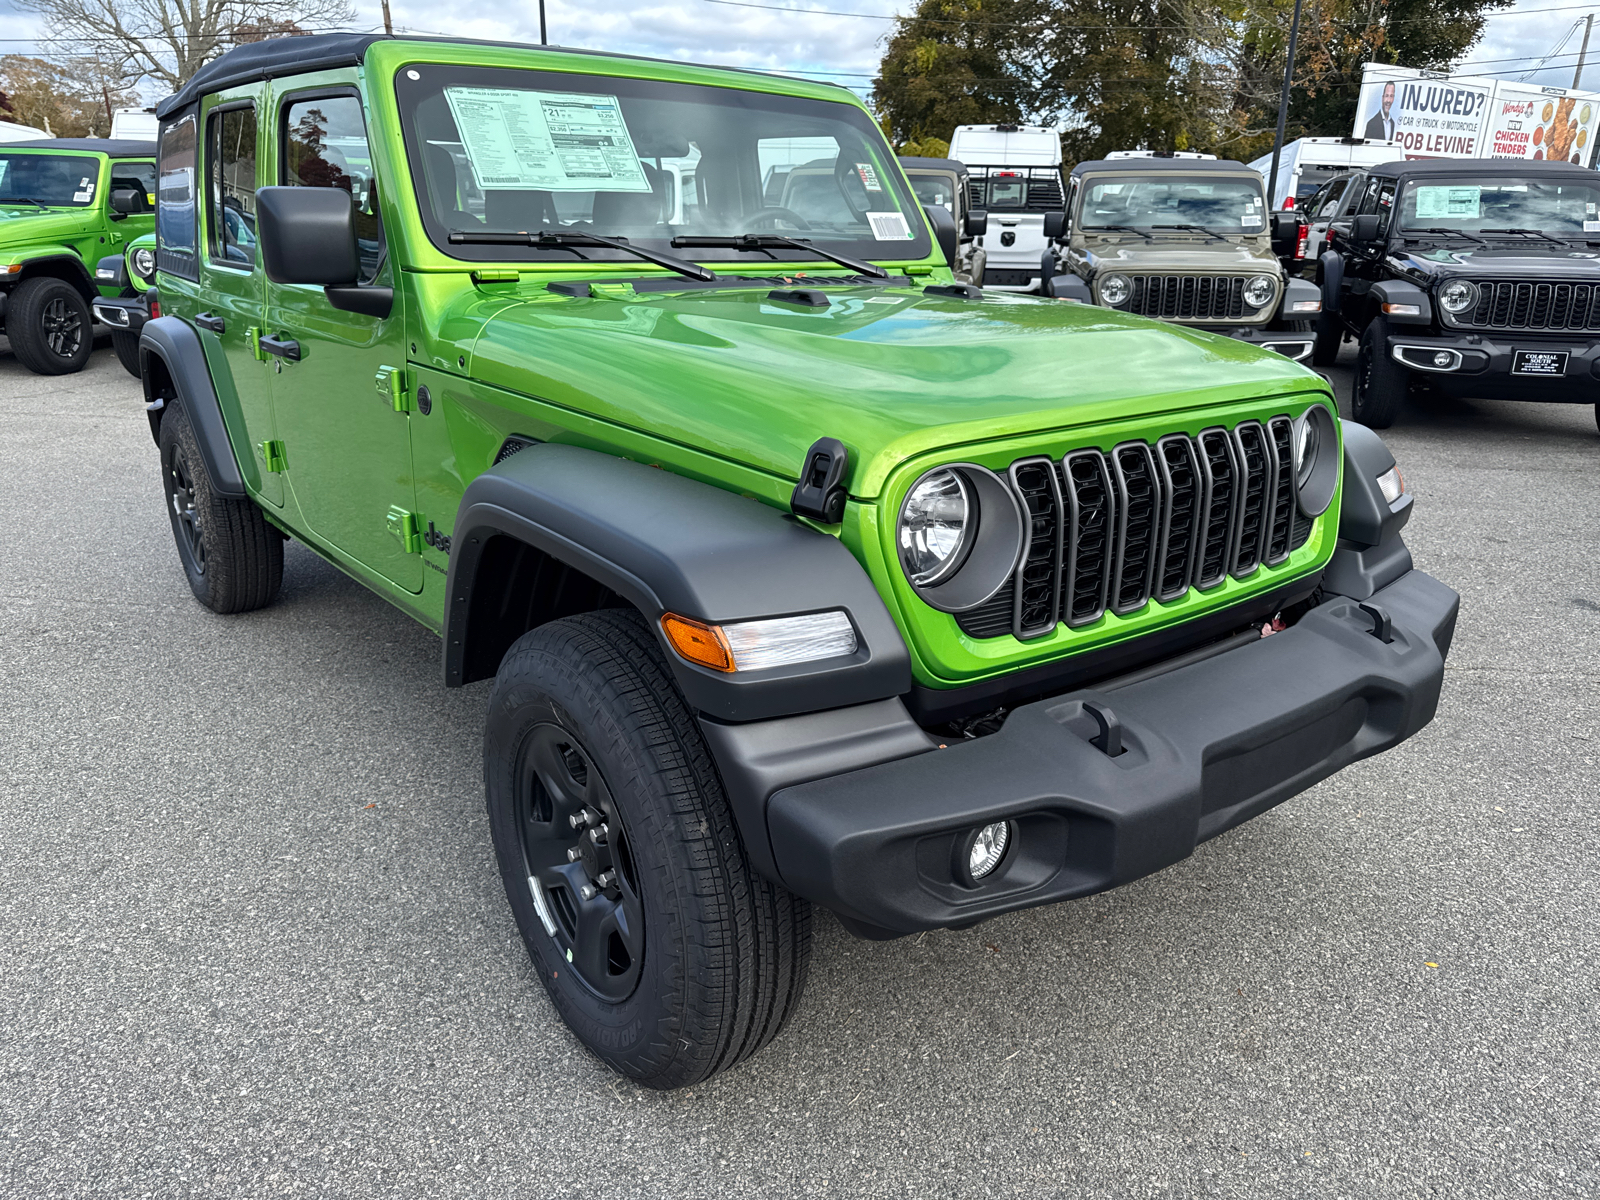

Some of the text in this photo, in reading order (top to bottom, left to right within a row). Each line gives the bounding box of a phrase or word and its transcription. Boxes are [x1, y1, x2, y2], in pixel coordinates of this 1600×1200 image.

[1400, 83, 1485, 118] INJURED?
[548, 108, 560, 117] 21
[1502, 101, 1524, 117] Wendy's
[1403, 116, 1478, 132] CAR TRUCK MOTORCYCLE
[1426, 134, 1475, 154] LEVINE
[1495, 130, 1530, 143] CHICKEN
[1493, 142, 1527, 155] TENDERS
[424, 520, 452, 555] Jee
